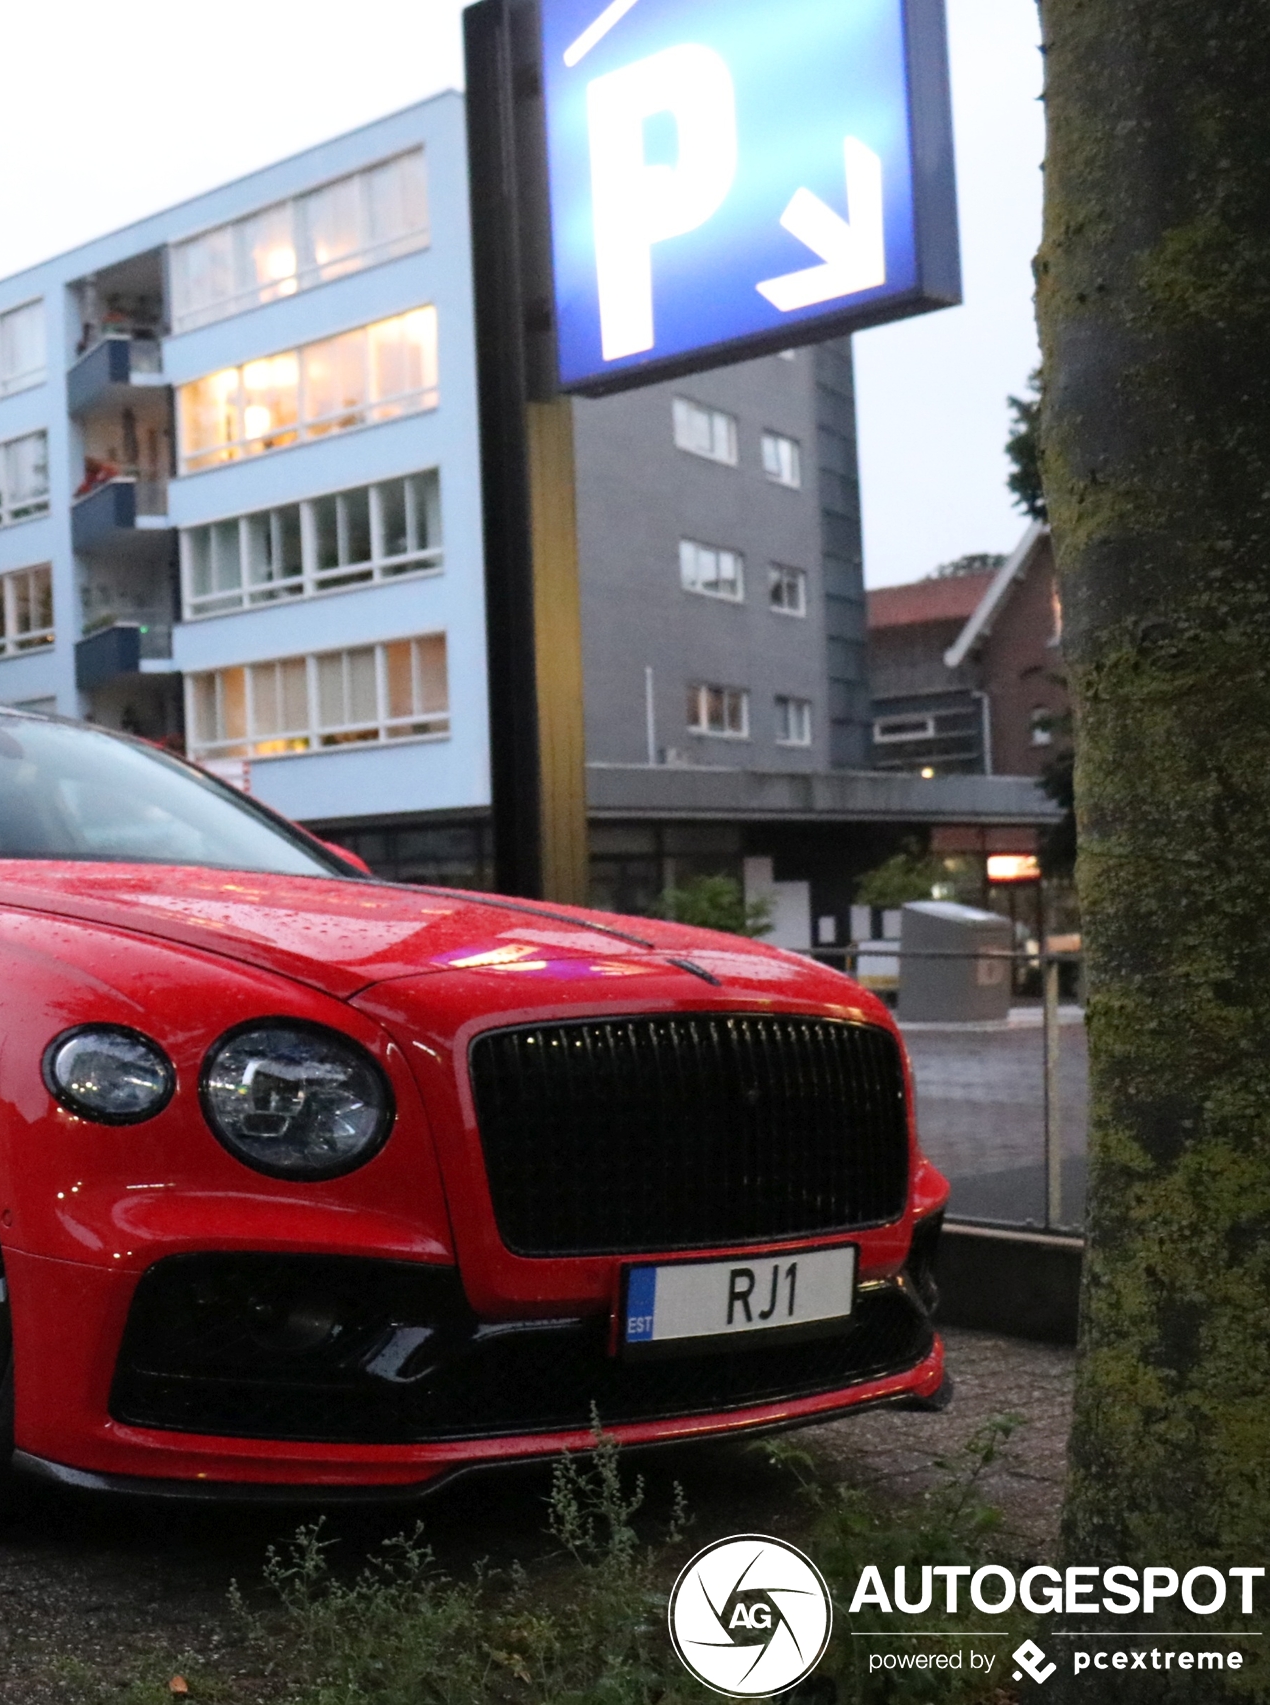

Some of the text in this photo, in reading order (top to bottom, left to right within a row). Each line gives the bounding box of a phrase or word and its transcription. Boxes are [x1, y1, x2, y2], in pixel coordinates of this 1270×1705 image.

[586, 42, 738, 361] P
[628, 1316, 653, 1333] EST
[726, 1261, 798, 1326] RJ1
